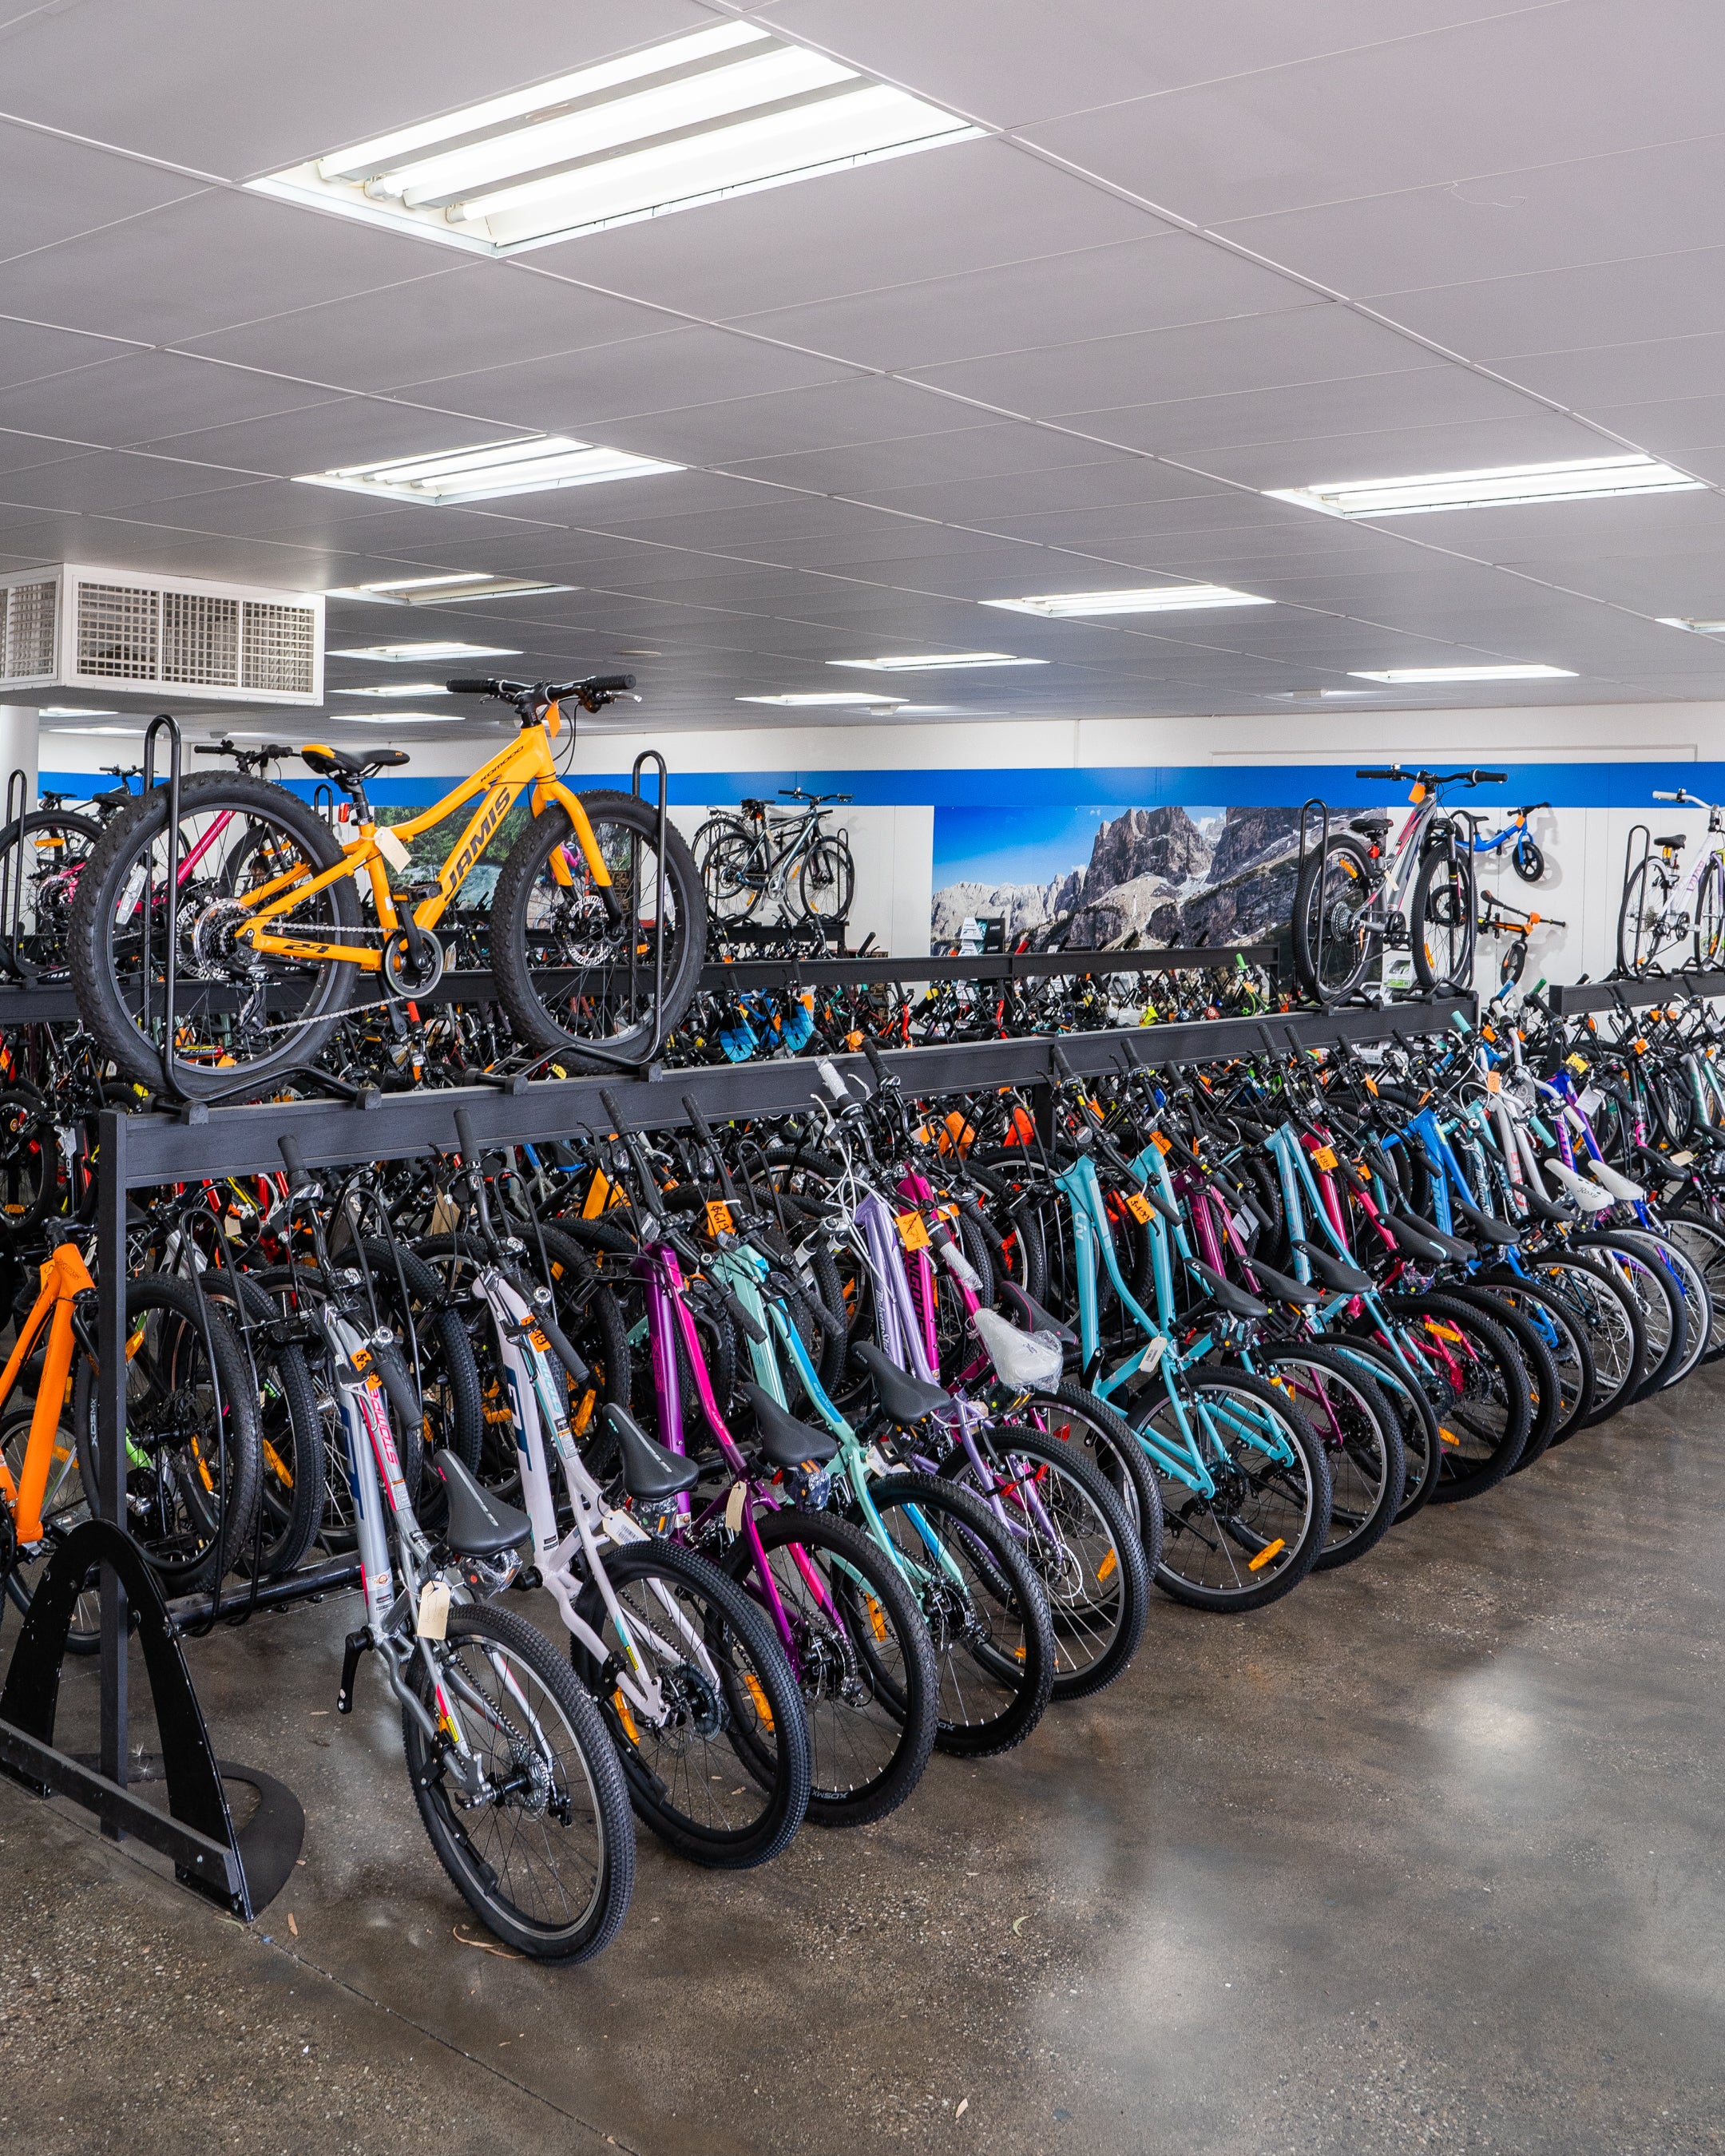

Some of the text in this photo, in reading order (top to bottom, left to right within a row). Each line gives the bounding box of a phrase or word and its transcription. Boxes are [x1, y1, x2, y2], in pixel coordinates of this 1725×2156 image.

[444, 787, 511, 902] JAMIS
[284, 941, 330, 953] 24
[1430, 1177, 1449, 1231] AMIS
[1576, 1186, 1599, 1199] Roxy
[1074, 1211, 1088, 1241] Liv
[1192, 1206, 1204, 1231] Liv
[1243, 1258, 1253, 1268] Liv
[1299, 1245, 1309, 1254] Liv
[1191, 1262, 1202, 1272] Liv
[875, 1288, 888, 1333] Malvern
[650, 1333, 665, 1393] XDS
[536, 1353, 563, 1415] STOMP
[367, 1387, 399, 1466] STOMPE
